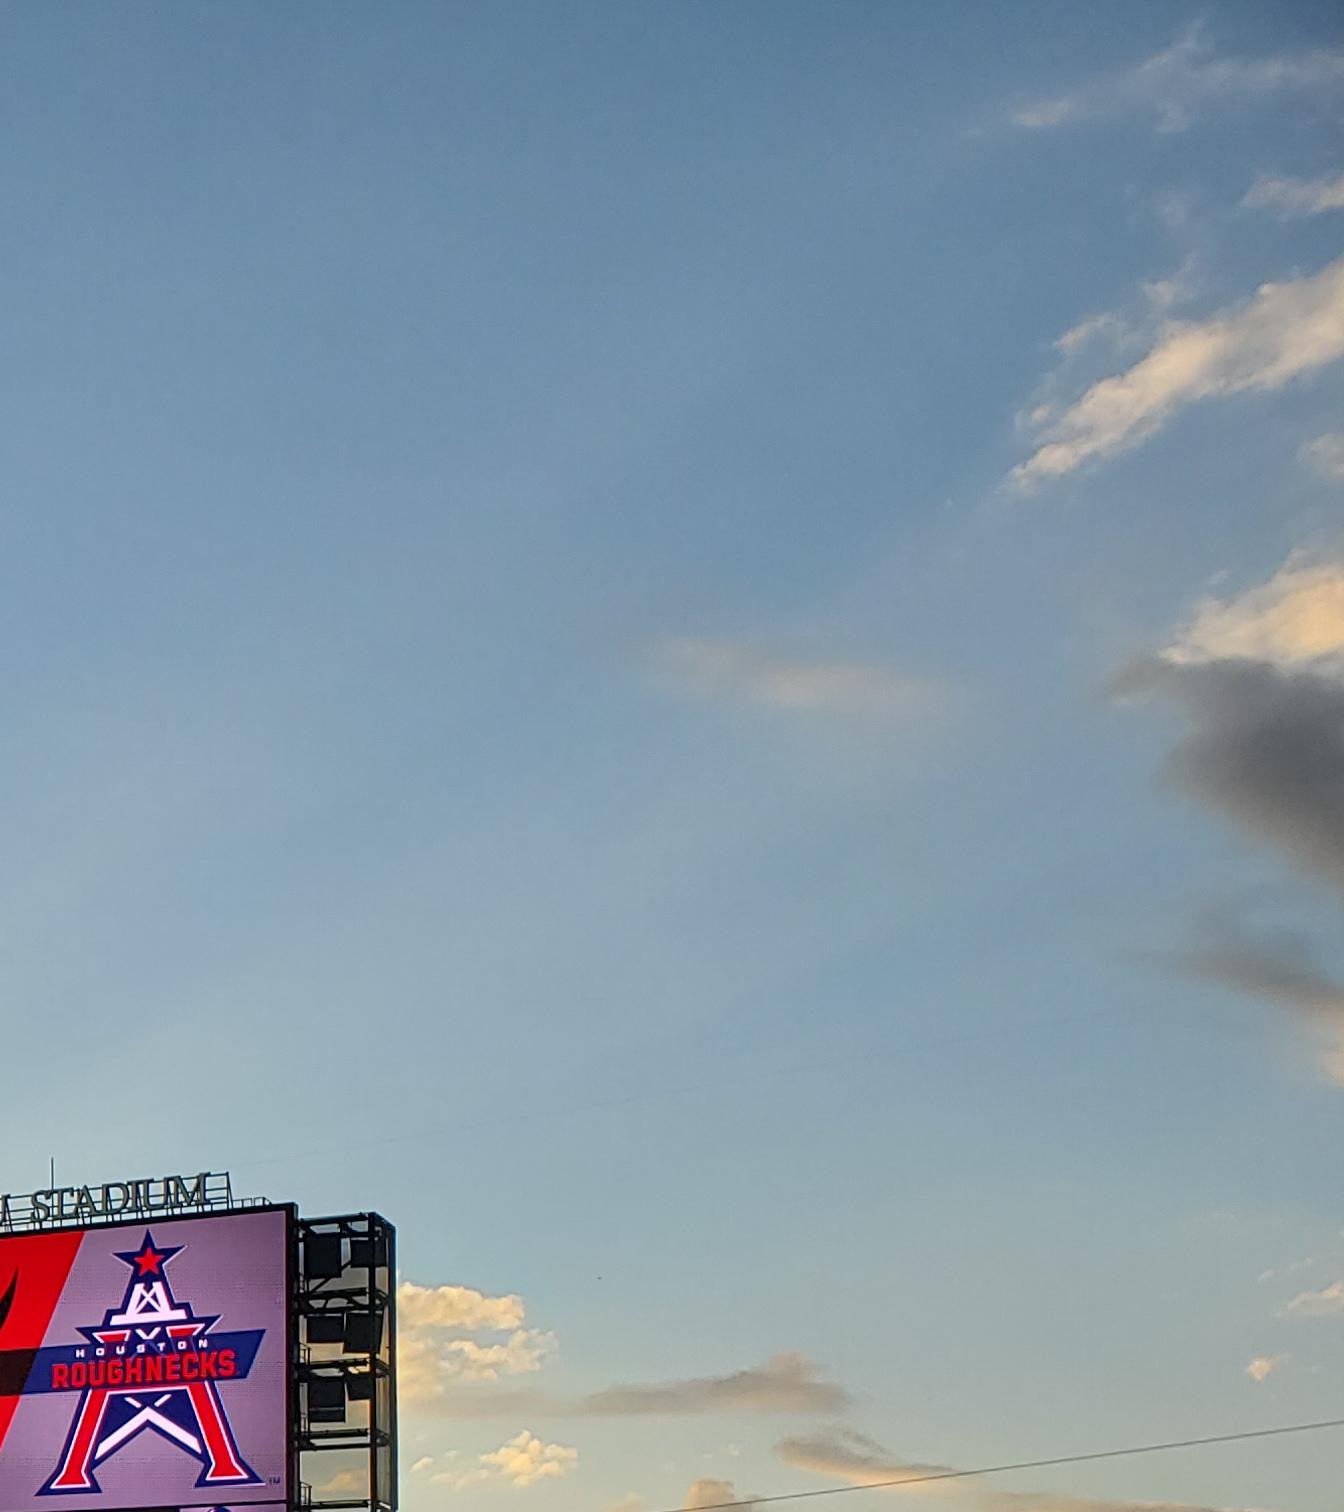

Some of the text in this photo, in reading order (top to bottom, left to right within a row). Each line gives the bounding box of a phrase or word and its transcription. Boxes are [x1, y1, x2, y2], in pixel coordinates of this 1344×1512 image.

[31, 1172, 211, 1222] STADIUM
[76, 1339, 208, 1357] HOUSTON
[52, 1350, 236, 1389] ROUGHNECKS
